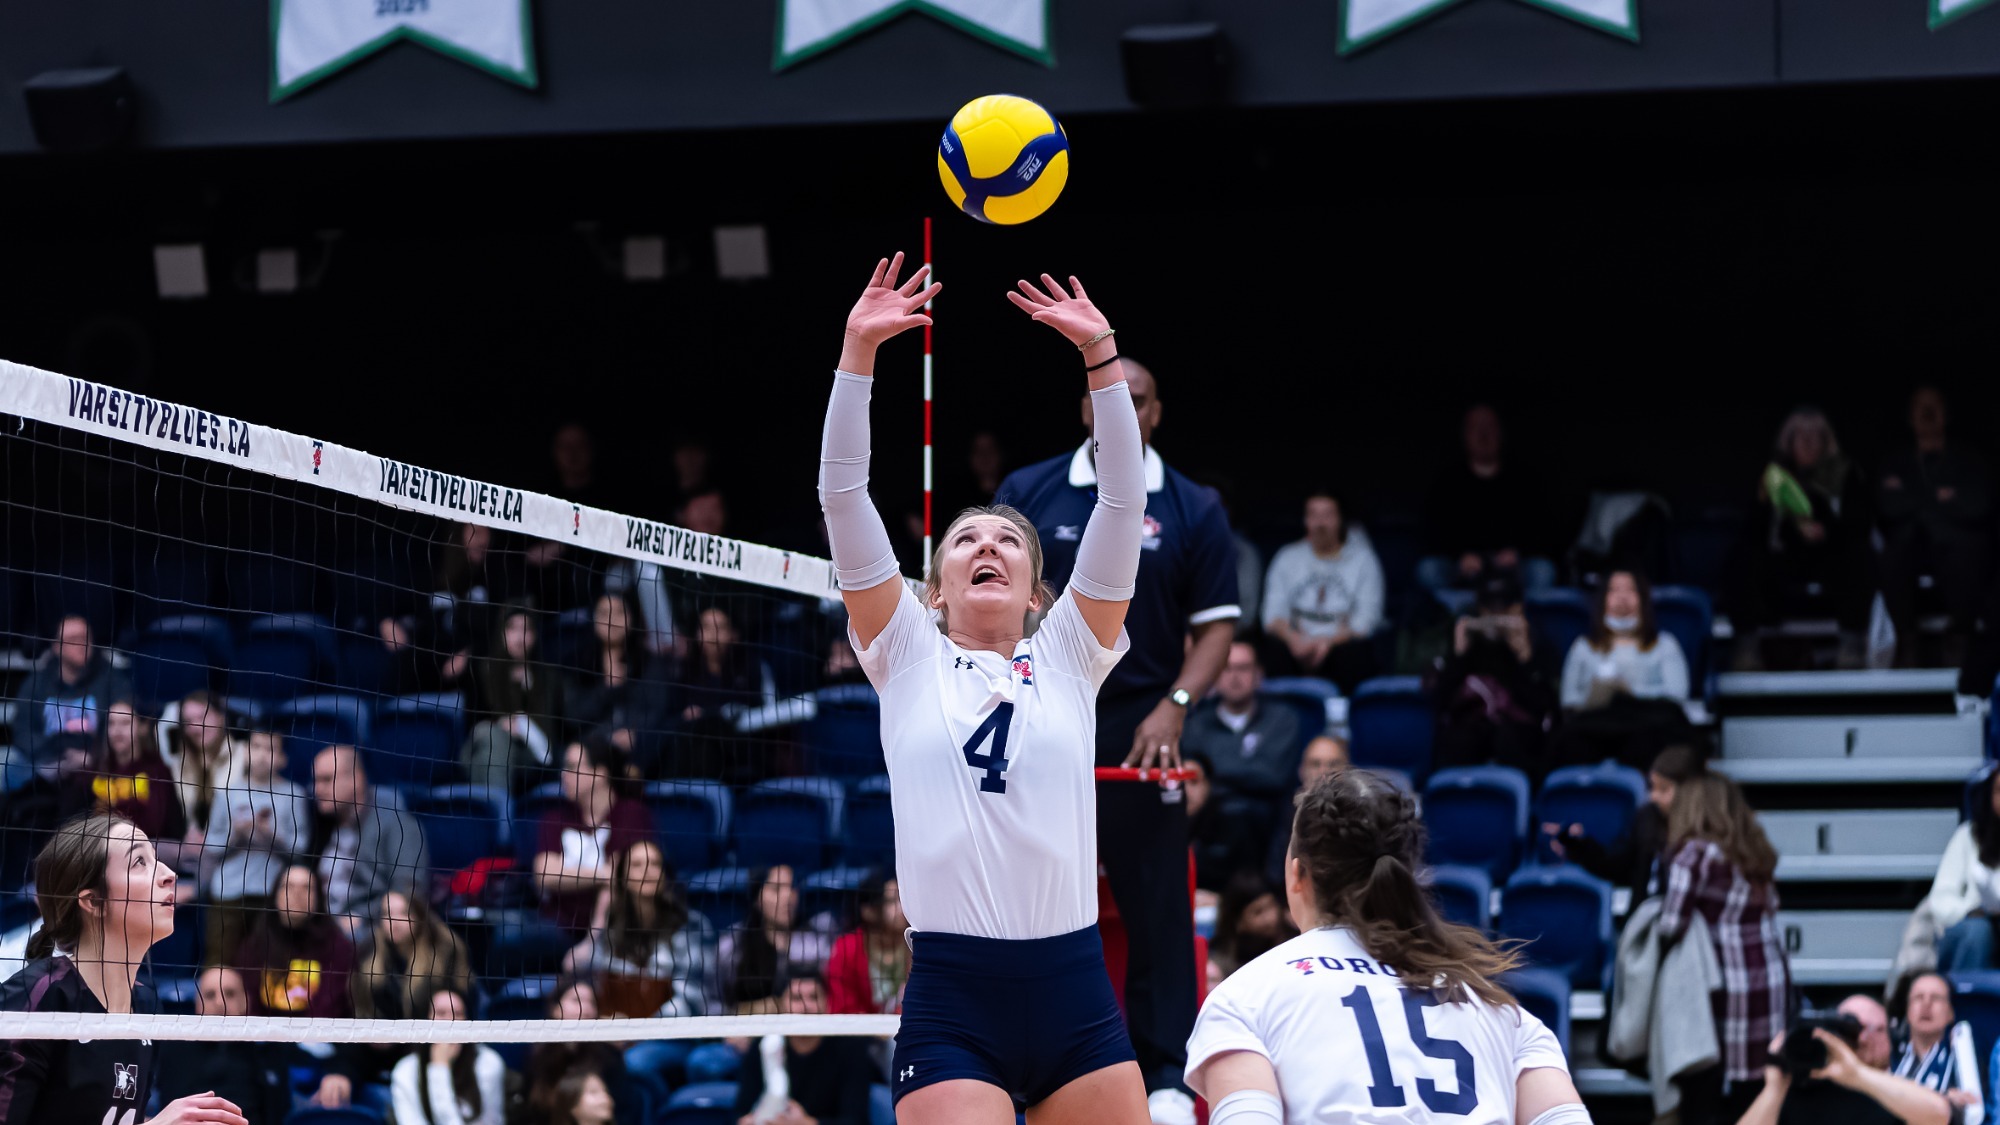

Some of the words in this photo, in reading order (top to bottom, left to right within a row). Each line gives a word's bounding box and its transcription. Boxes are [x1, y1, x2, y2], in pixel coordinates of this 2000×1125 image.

[1023, 157, 1043, 181] FIVB
[68, 378, 250, 457] VARSITYBLUES.CA
[379, 458, 522, 523] VARSITYBLUES.CA
[626, 518, 741, 571] VARSITYBLUES.CA
[962, 700, 1015, 795] 4
[1286, 956, 1402, 978] TORO
[1341, 985, 1479, 1116] 15
